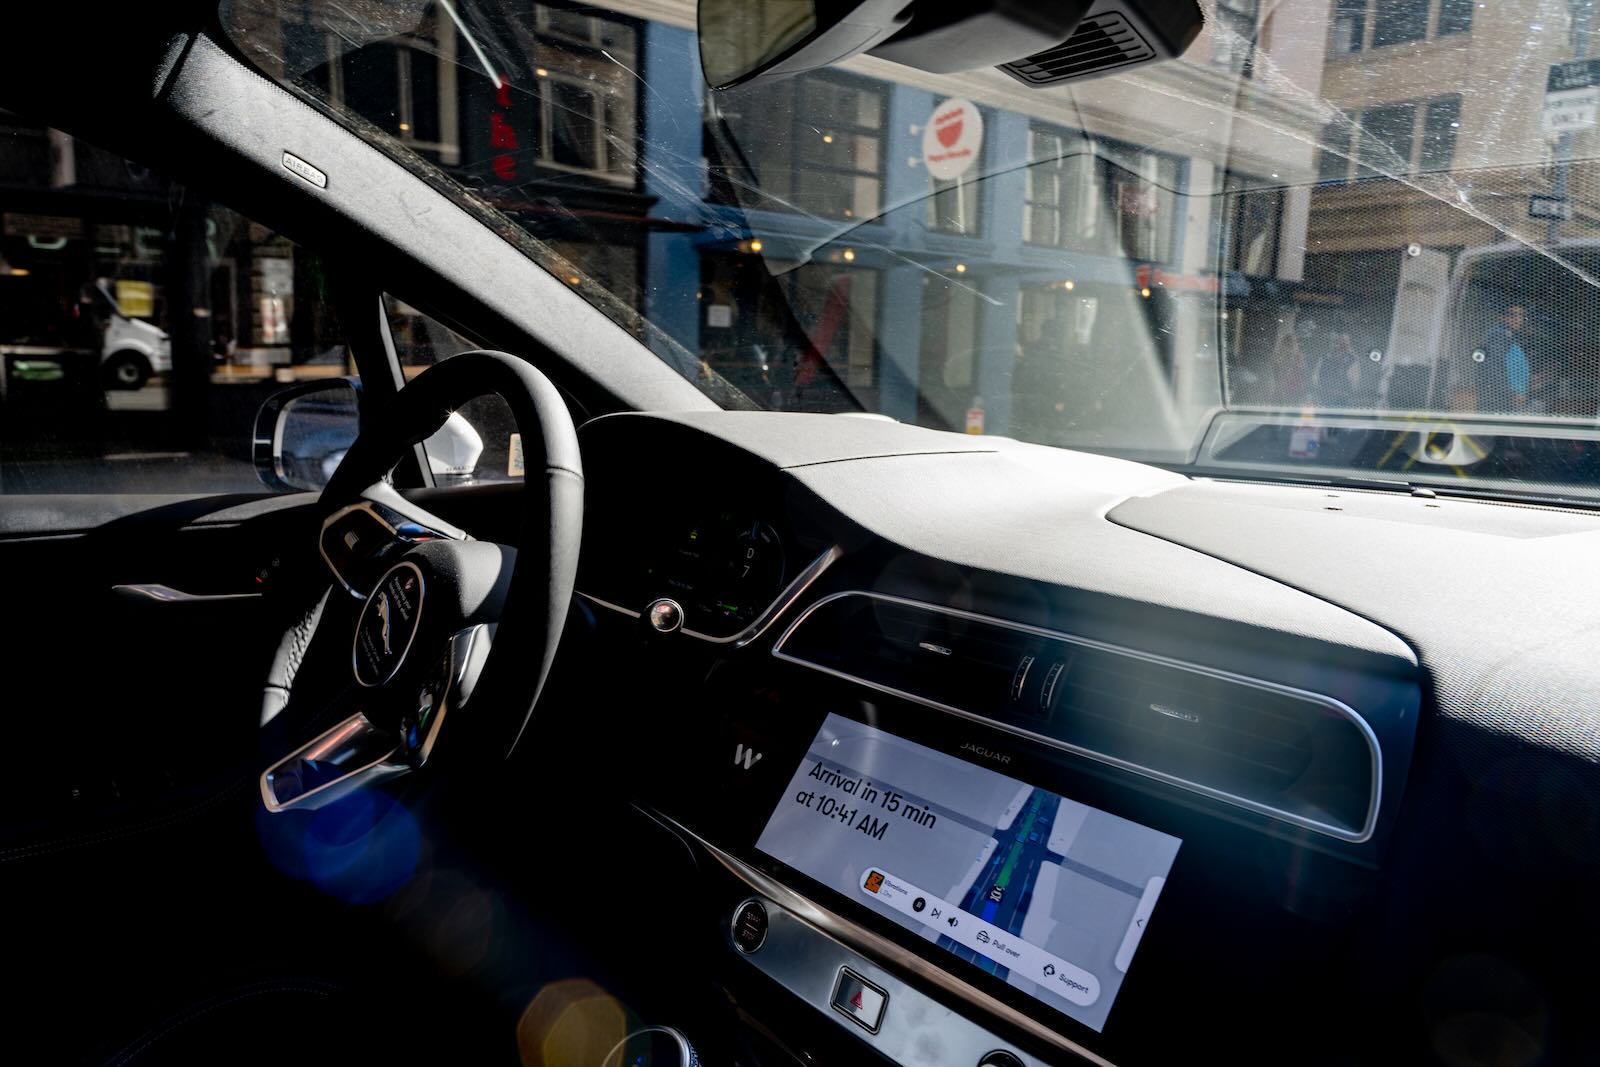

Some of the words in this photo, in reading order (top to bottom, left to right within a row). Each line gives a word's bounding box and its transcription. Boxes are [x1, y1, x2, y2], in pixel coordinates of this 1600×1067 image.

[285, 158, 324, 183] AIRBAG
[959, 742, 1012, 765] JAGUAR
[808, 761, 863, 796] Arrival
[861, 782, 878, 804] in
[881, 791, 903, 813] 15
[901, 805, 937, 829] min
[795, 791, 815, 808] at
[816, 795, 858, 826] 10:41
[855, 814, 889, 841] AM
[992, 939, 1006, 951] Pull
[1005, 948, 1021, 958] over
[1059, 973, 1089, 994] Support
